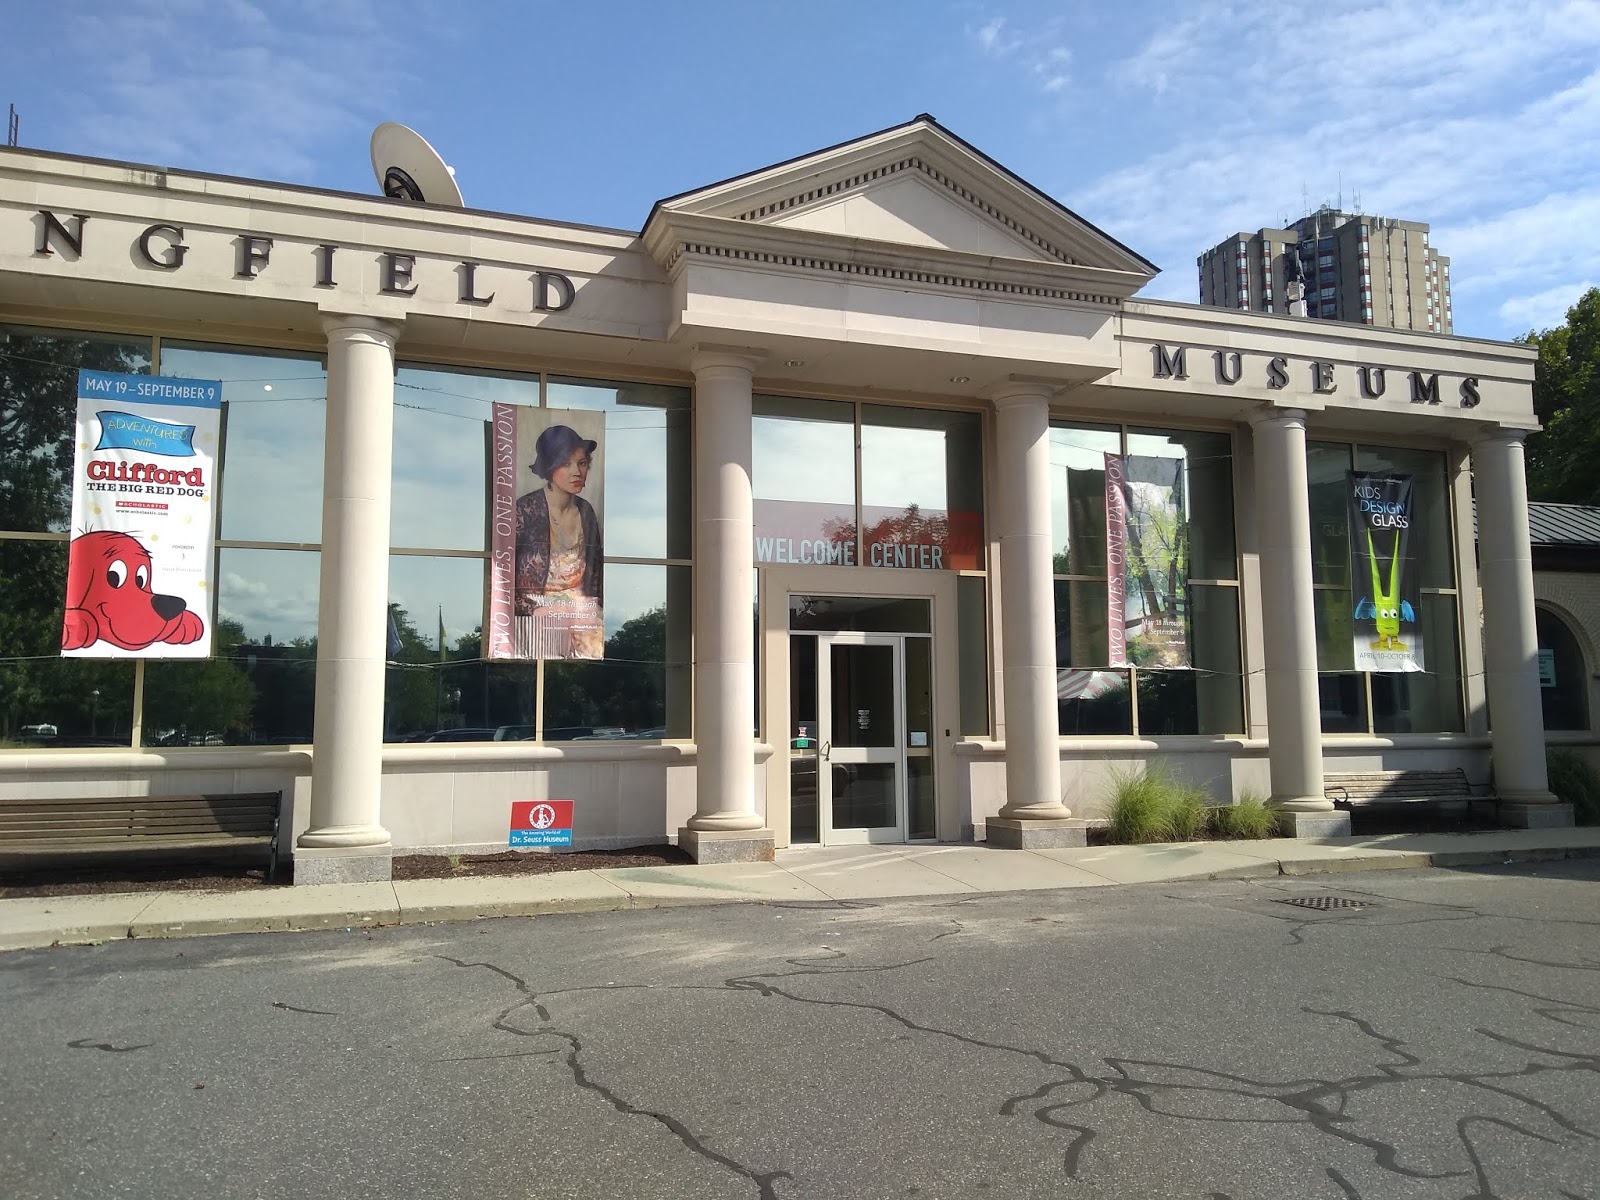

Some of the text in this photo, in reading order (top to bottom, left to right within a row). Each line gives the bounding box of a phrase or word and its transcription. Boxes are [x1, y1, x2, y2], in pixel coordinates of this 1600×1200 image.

[1152, 343, 1481, 408] MUSEUMS
[86, 377, 112, 394] MAY
[207, 387, 215, 400] 9
[107, 418, 188, 441] ADVENTURES
[132, 437, 157, 449] with
[86, 460, 205, 487] Clifford
[86, 482, 204, 498] THE BIG RED DOG
[1354, 485, 1381, 500] KIDS
[1360, 499, 1405, 514] DESIGN
[1371, 513, 1409, 529] GLASS
[494, 404, 514, 658] TWO LIVES, ONE PASSION
[755, 536, 944, 570] WELCOME CENTER
[1108, 454, 1124, 667] TWO LIVES, ONE PASSION
[536, 599, 554, 609] May
[568, 599, 597, 610] through
[548, 610, 597, 621] September 9
[1150, 628, 1179, 637] September
[511, 836, 522, 844] Dr.
[542, 836, 569, 844] Museum
